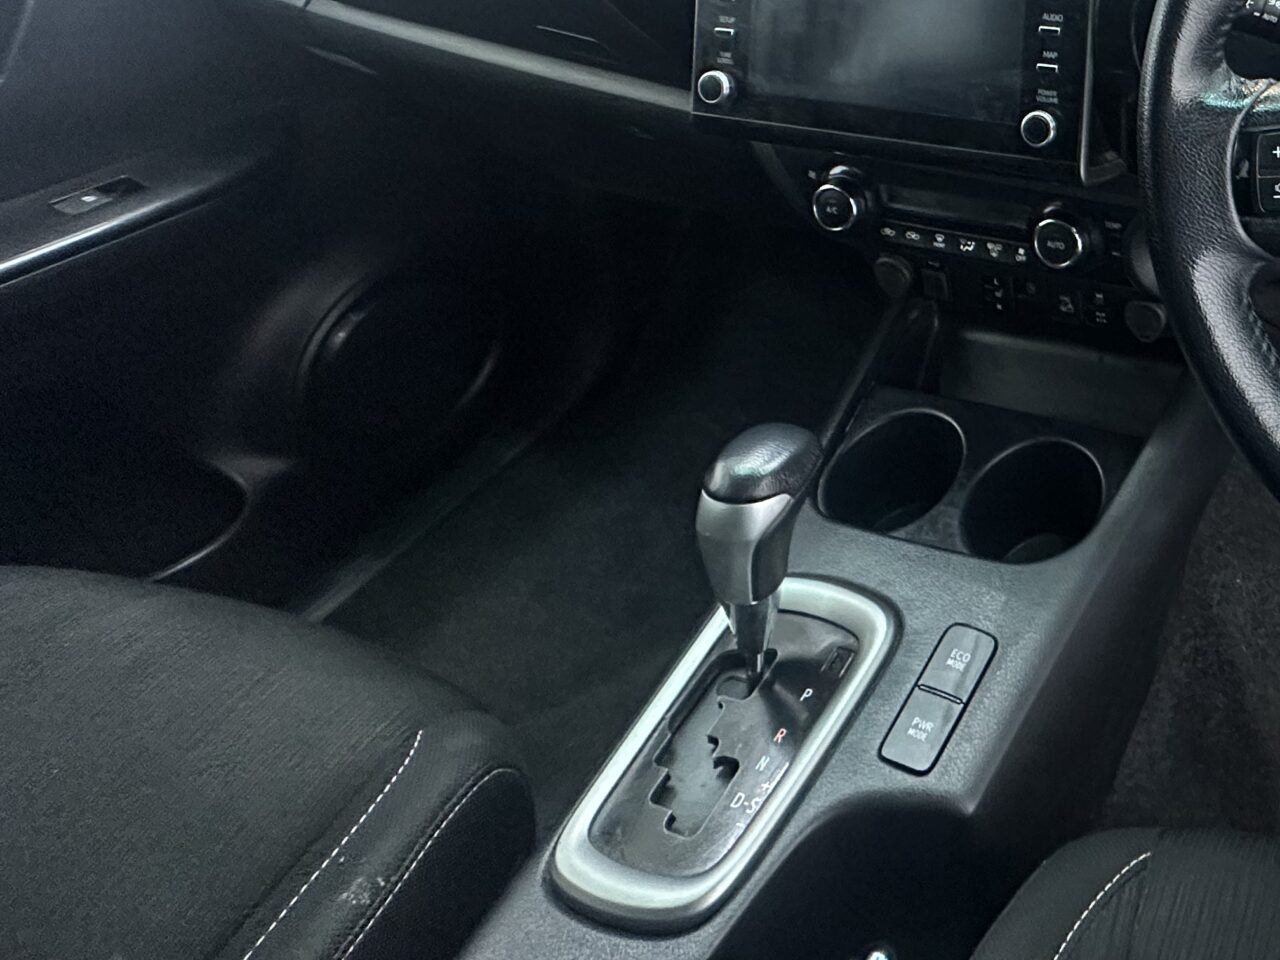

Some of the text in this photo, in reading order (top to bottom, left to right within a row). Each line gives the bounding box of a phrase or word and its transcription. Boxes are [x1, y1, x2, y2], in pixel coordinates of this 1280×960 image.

[1042, 12, 1063, 22] AUDIO
[1043, 50, 1058, 59] MAP
[1047, 240, 1065, 250] AUTO
[950, 648, 971, 663] ECO
[945, 657, 967, 672] MODE
[799, 688, 813, 701] P
[911, 716, 934, 732] PWR
[773, 727, 787, 744] R
[907, 727, 928, 742] MODE
[755, 755, 770, 772] N
